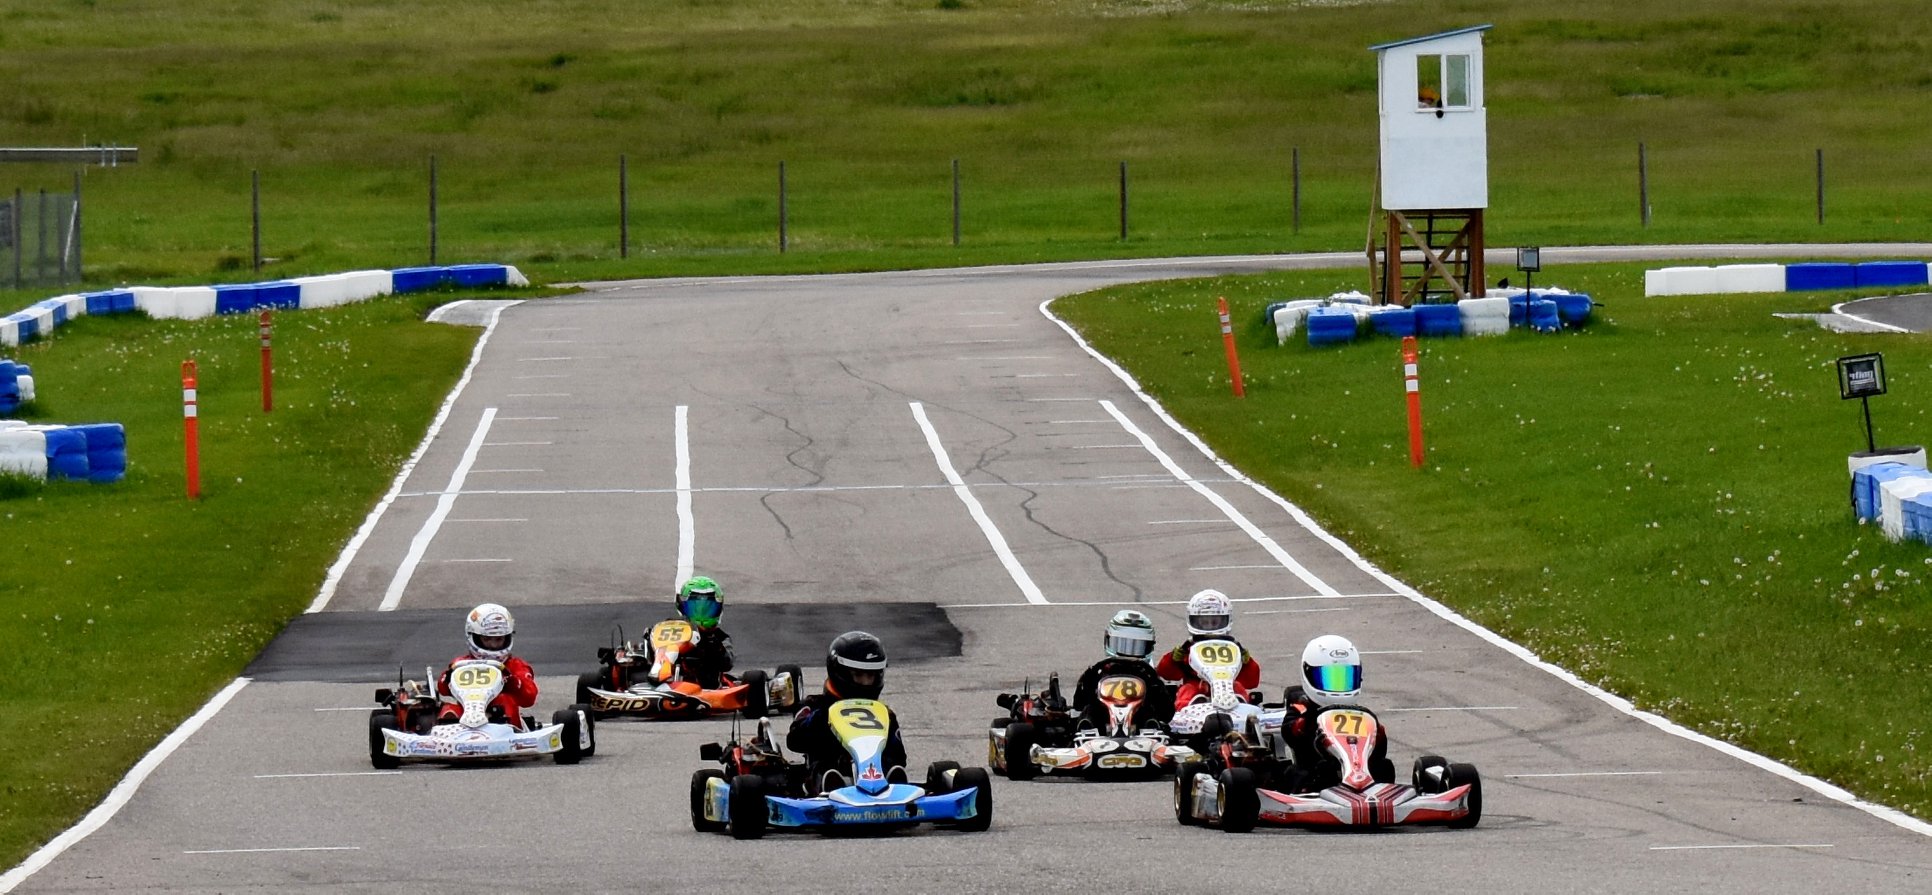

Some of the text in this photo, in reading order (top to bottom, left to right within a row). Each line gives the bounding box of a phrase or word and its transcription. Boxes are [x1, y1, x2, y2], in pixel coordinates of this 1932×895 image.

[657, 628, 684, 642] 55
[1201, 646, 1234, 663] 99
[459, 668, 491, 686] 95
[1103, 680, 1138, 698] 78
[840, 707, 884, 729] 3
[1334, 714, 1363, 735] 27
[834, 808, 925, 821] www.flowlift.cm
